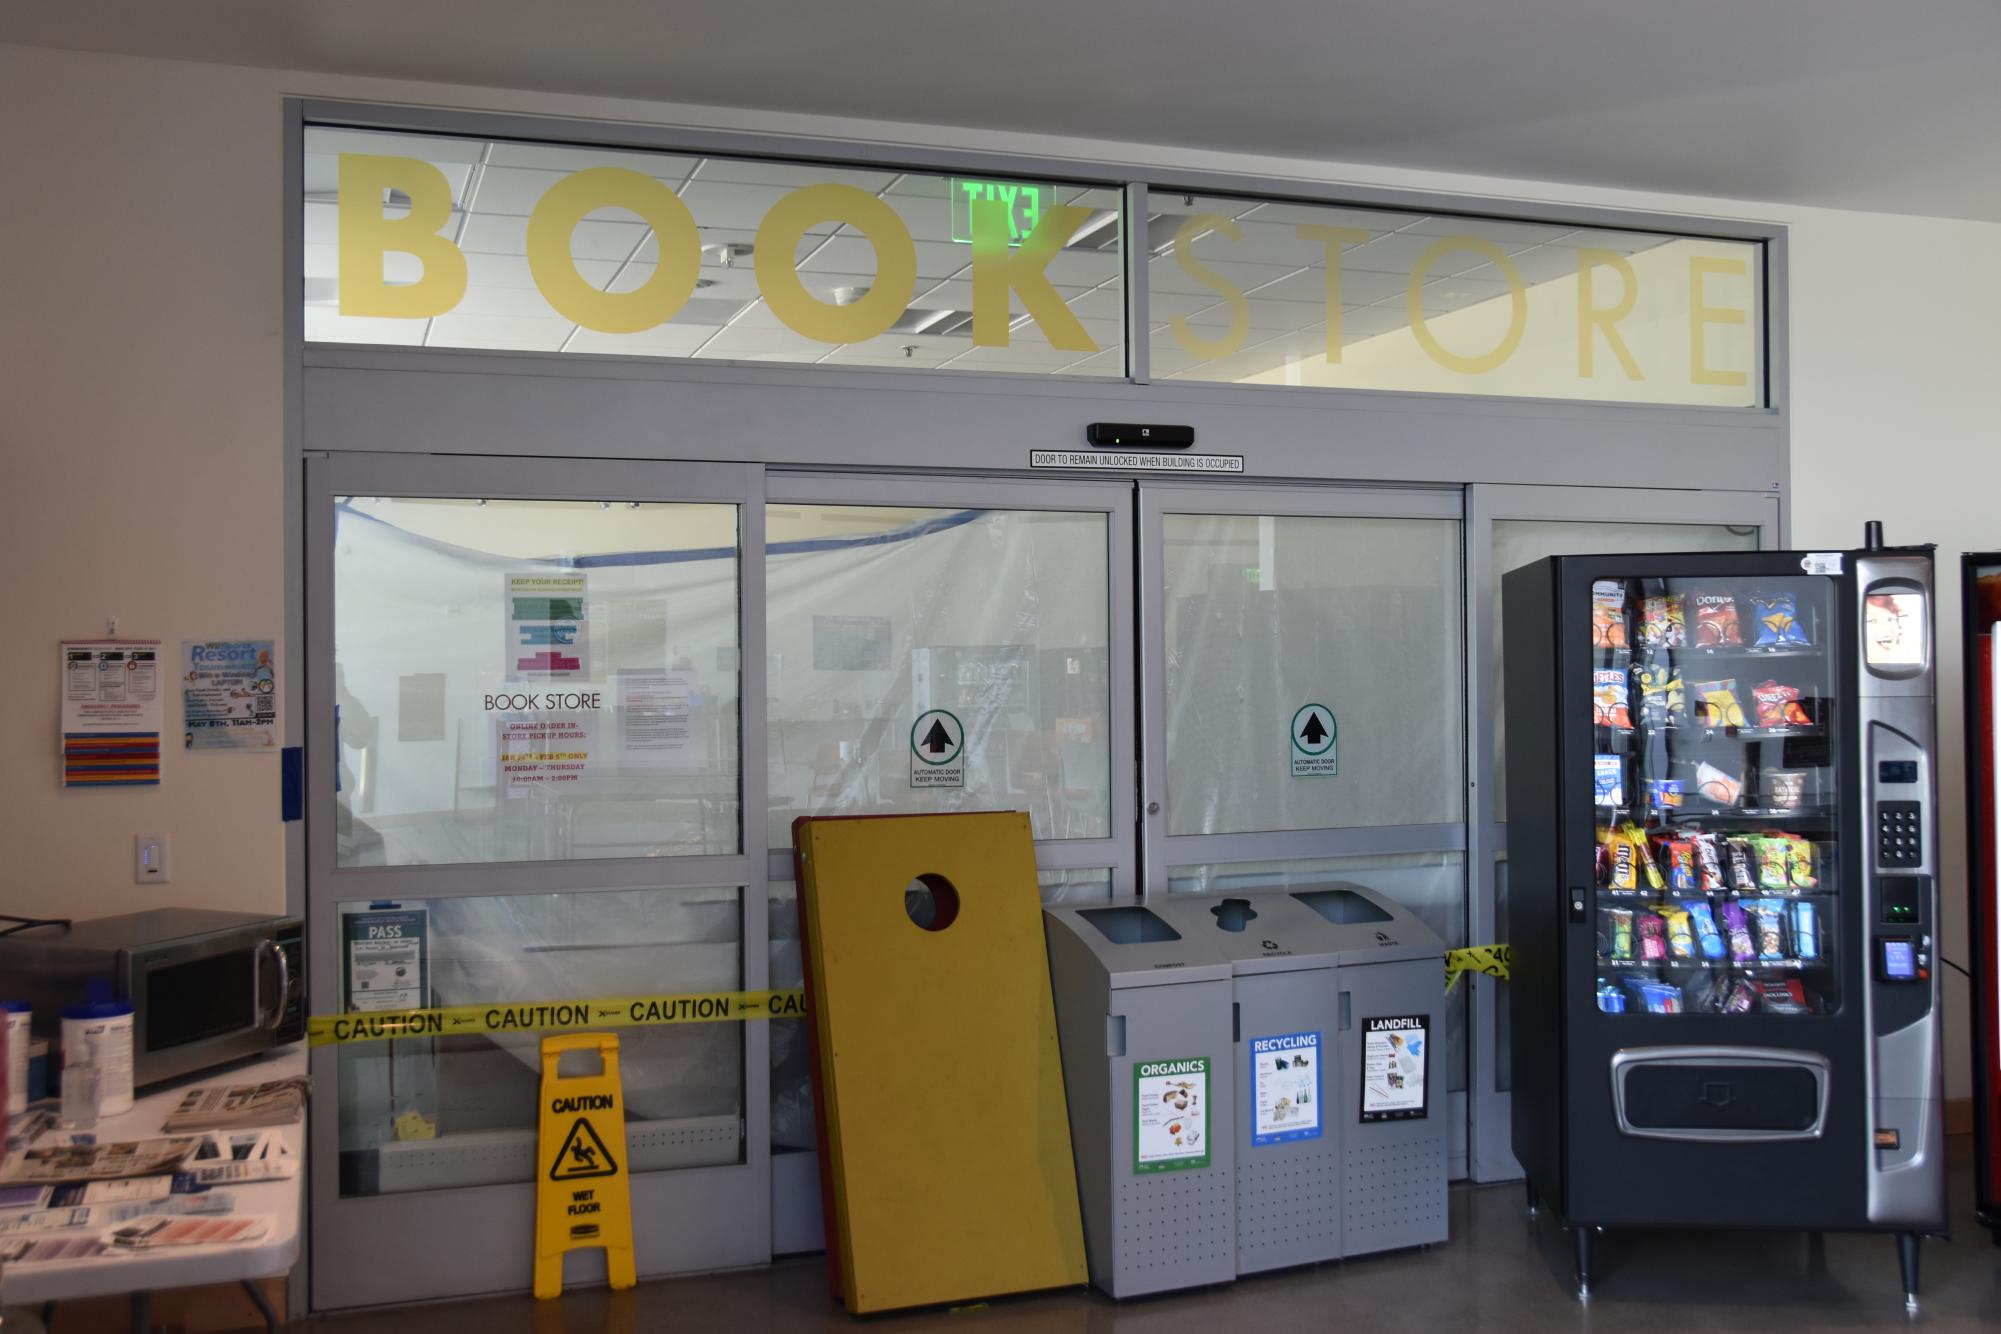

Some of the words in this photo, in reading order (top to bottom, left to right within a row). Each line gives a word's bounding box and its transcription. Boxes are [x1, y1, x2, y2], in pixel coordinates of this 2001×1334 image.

[338, 152, 1098, 352] BOOK
[1168, 211, 1750, 388] STORE
[1035, 453, 1056, 464] DOOR
[1058, 454, 1068, 464] TO
[1069, 454, 1098, 465] REMAIN
[1100, 455, 1138, 466] UNLOCKED
[1139, 456, 1161, 467] WHEN
[1163, 457, 1195, 468] BUILDING
[1196, 458, 1203, 468] IS
[1205, 458, 1240, 469] OCCUPIED
[191, 644, 257, 662] Resort
[484, 693, 540, 711] BOOK
[545, 692, 601, 710] STORE
[510, 722, 539, 730] ONLINE
[504, 764, 538, 772] MONDAY
[545, 763, 585, 771] THURSDAY
[368, 925, 402, 939] PASS
[485, 1004, 590, 1029] CAUTION
[629, 997, 730, 1022] CAUTION
[334, 1013, 443, 1040] CAUTION
[1371, 1017, 1422, 1031] LANDFILL
[1254, 1034, 1317, 1052] RECYCLING
[1140, 1060, 1205, 1076] ORGANICS
[552, 1094, 613, 1113] CAUTION
[573, 1190, 595, 1202] WET
[567, 1202, 601, 1216] FLOOR
